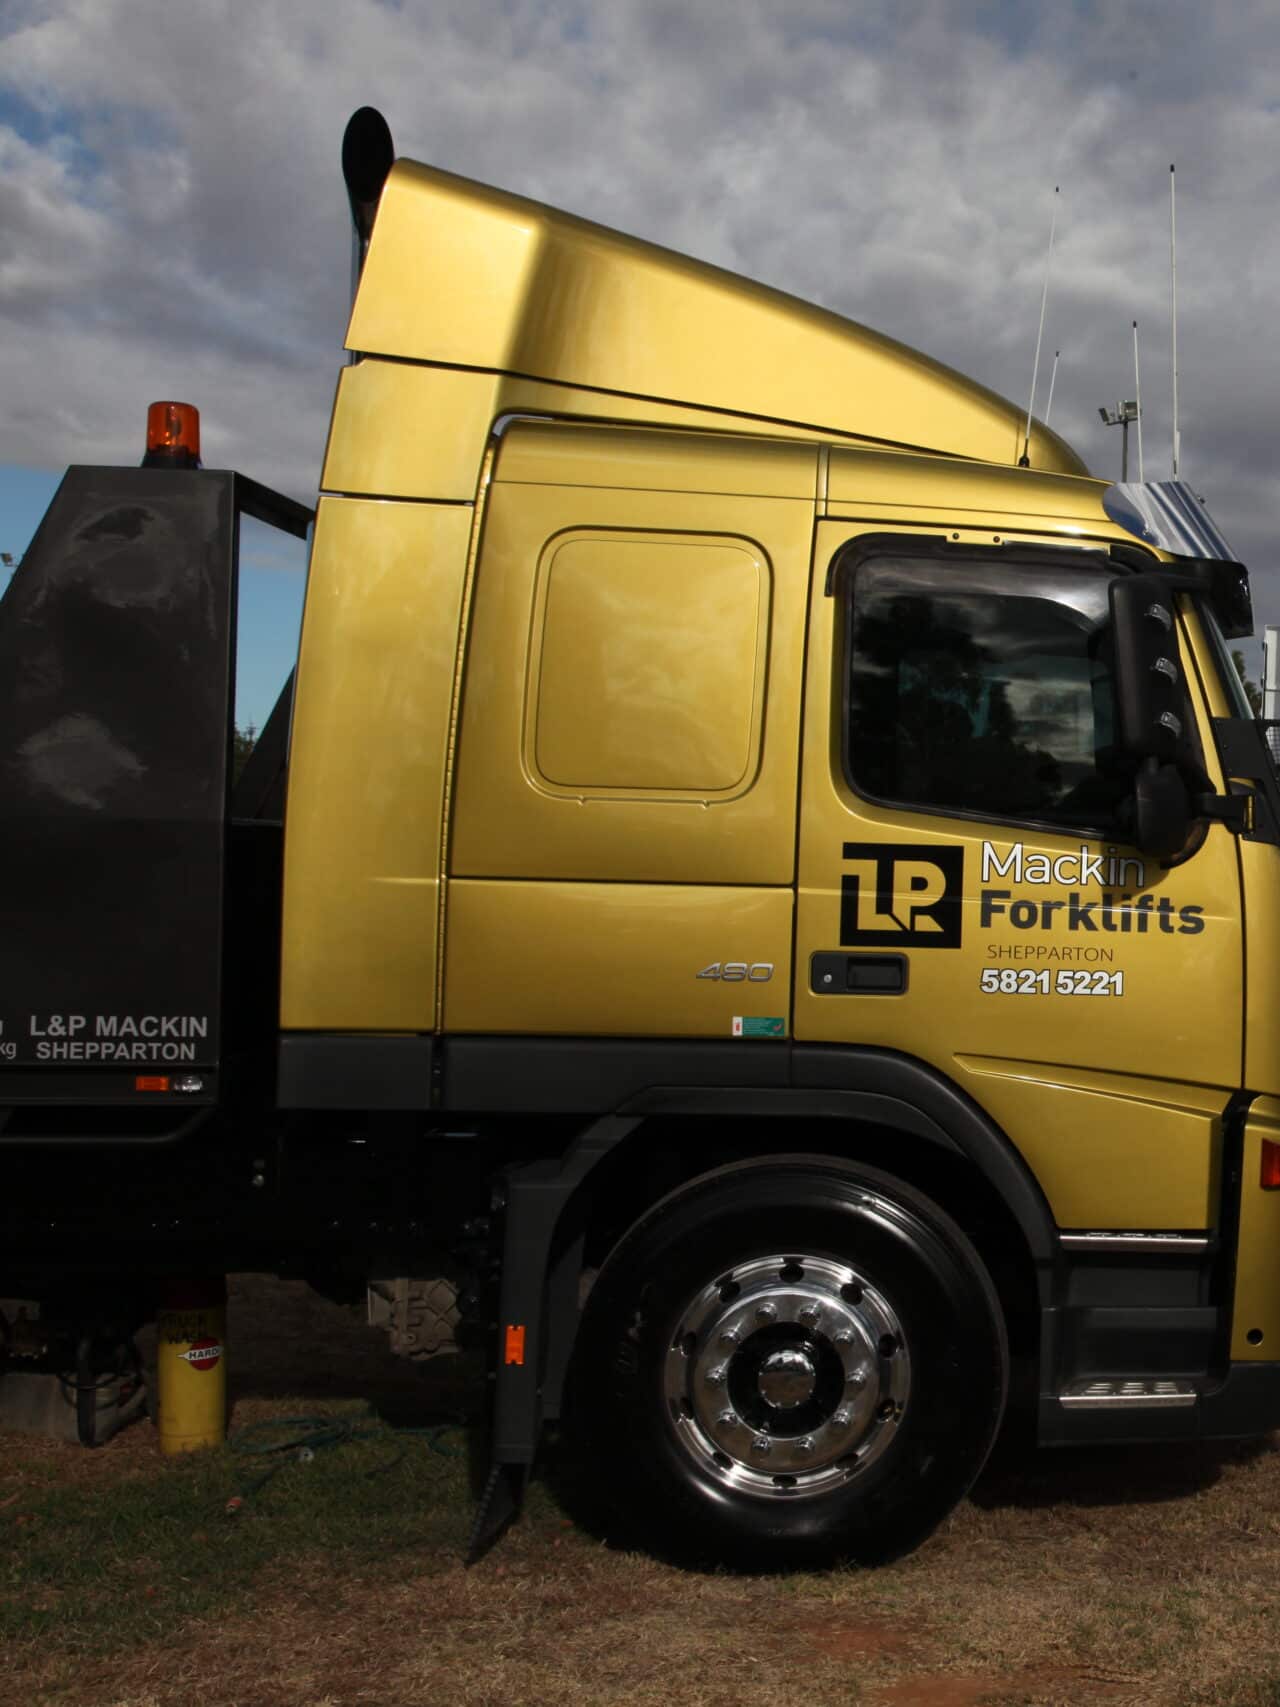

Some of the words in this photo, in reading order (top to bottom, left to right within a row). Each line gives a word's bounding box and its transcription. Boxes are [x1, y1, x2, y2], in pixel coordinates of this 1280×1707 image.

[981, 841, 1144, 888] Mackin
[980, 890, 1206, 934] Forklifts
[987, 945, 1113, 962] SHEPPARTON
[980, 968, 1050, 995] 5821
[1055, 970, 1124, 996] 5221
[30, 1015, 86, 1036] L&P
[96, 1016, 208, 1037] MACKIN
[36, 1042, 196, 1060] SHEPPARTON
